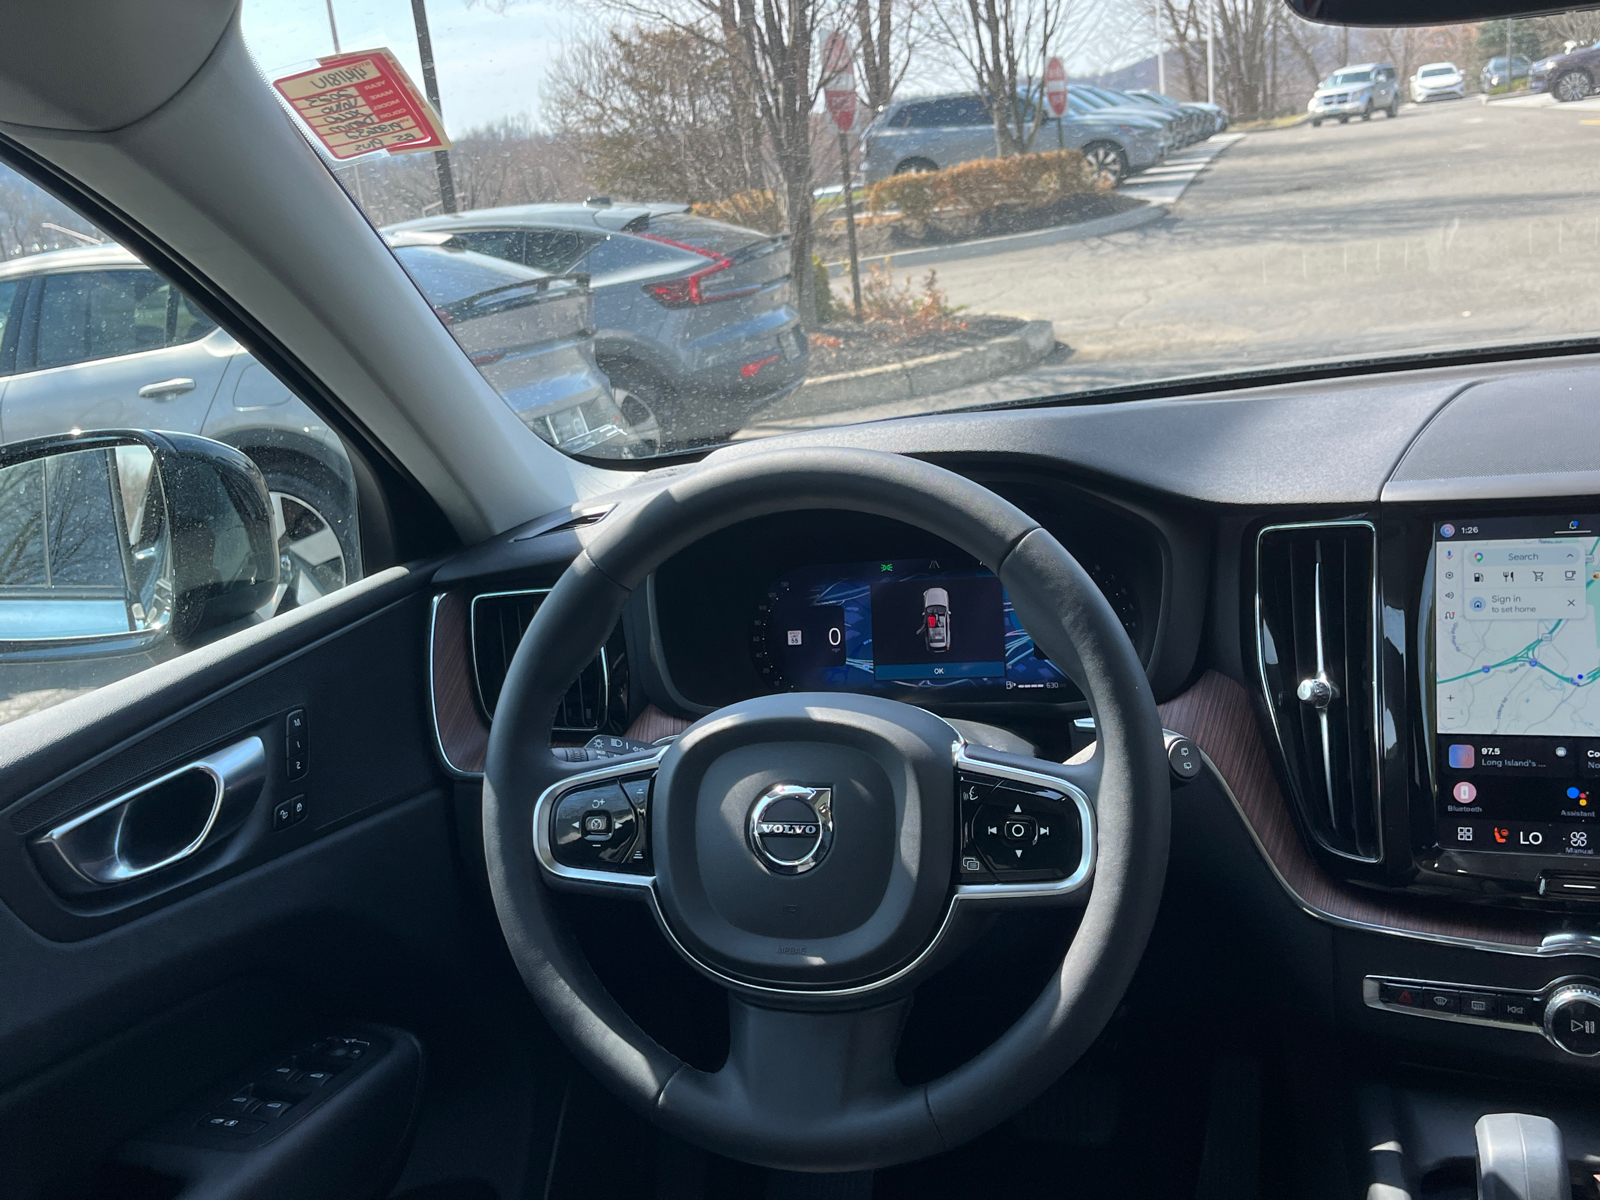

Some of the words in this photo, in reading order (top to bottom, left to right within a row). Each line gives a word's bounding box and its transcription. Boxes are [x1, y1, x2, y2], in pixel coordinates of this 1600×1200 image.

[1461, 526, 1479, 534] 1:26
[1508, 553, 1539, 562] Search
[1491, 595, 1511, 604] Sign
[1513, 595, 1521, 603] in
[829, 627, 841, 646] 0
[296, 761, 301, 769] 2
[1482, 759, 1502, 768] Long
[1561, 810, 1595, 818] Assistant
[761, 824, 817, 834] VOLVO
[1520, 831, 1542, 845] LO
